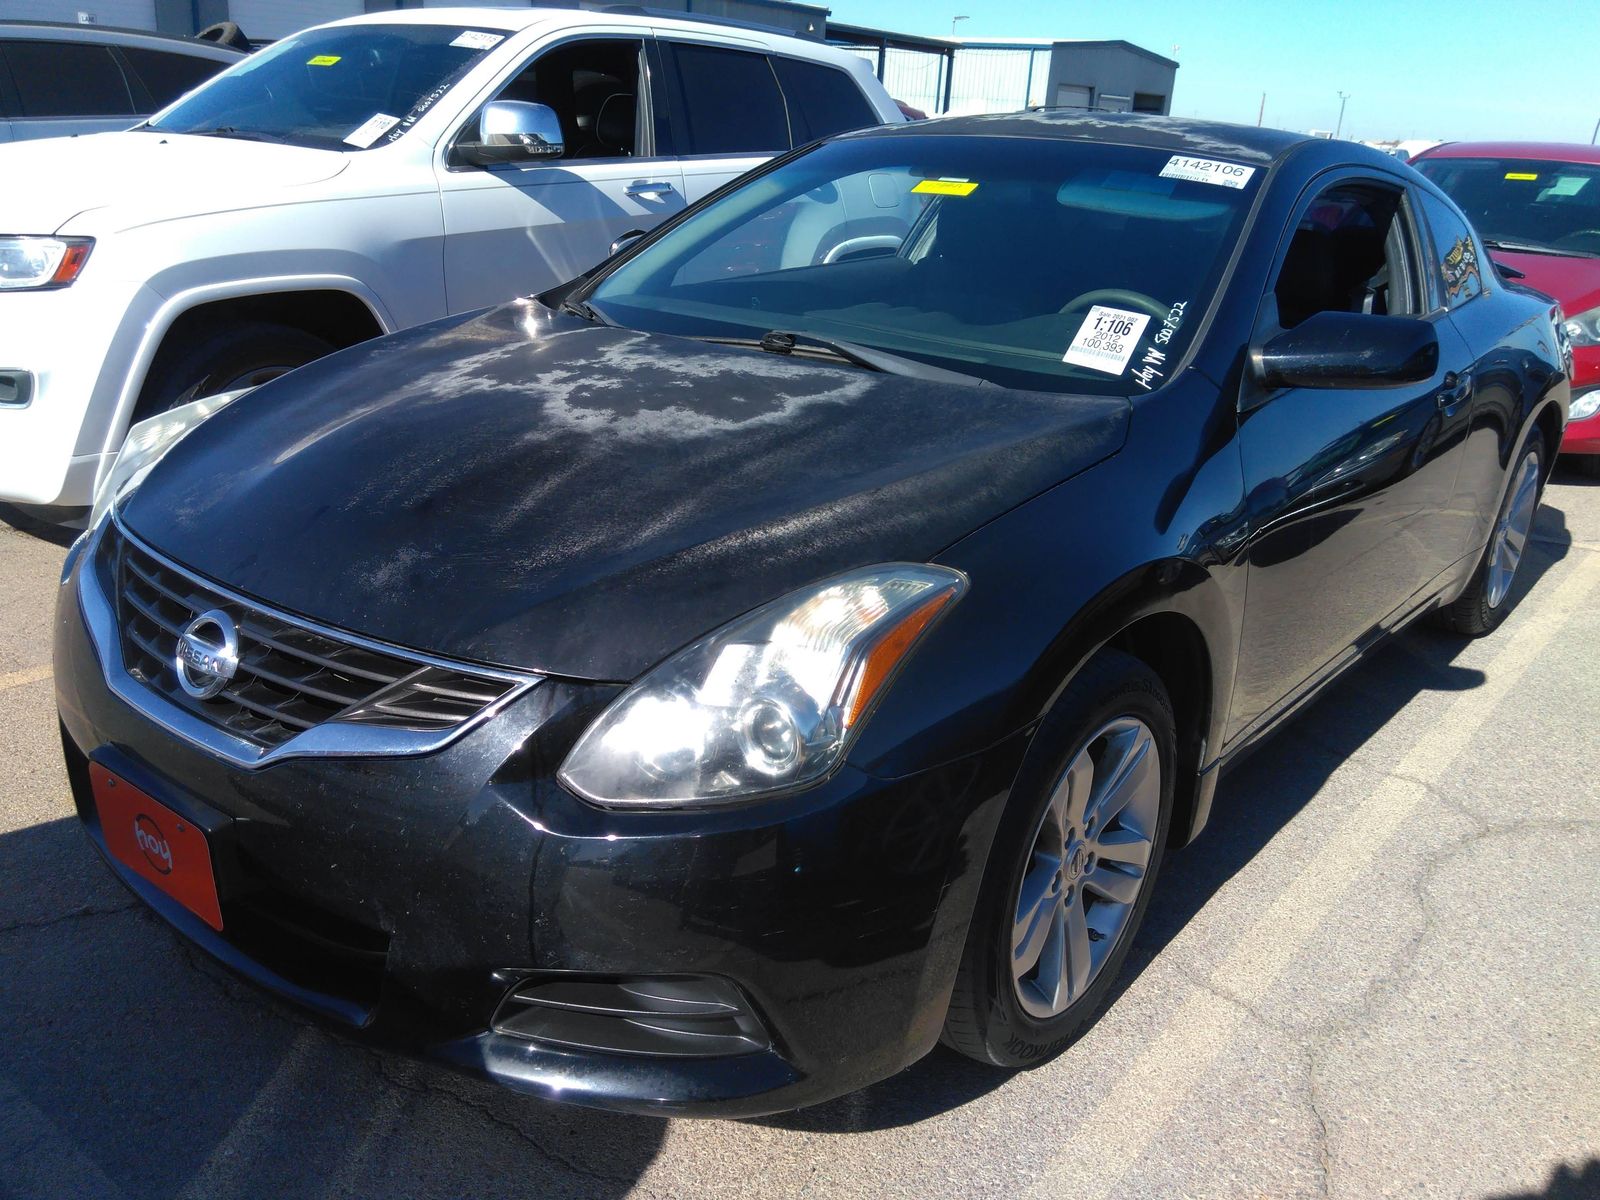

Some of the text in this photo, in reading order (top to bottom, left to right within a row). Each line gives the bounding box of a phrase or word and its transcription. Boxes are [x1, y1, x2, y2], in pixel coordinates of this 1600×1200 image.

[1169, 158, 1245, 177] 4142106
[1094, 317, 1133, 336] 1:106
[1082, 338, 1124, 354] 100,393
[1093, 331, 1121, 343] 2012
[176, 638, 225, 675] NISSAN
[134, 819, 173, 870] hoy
